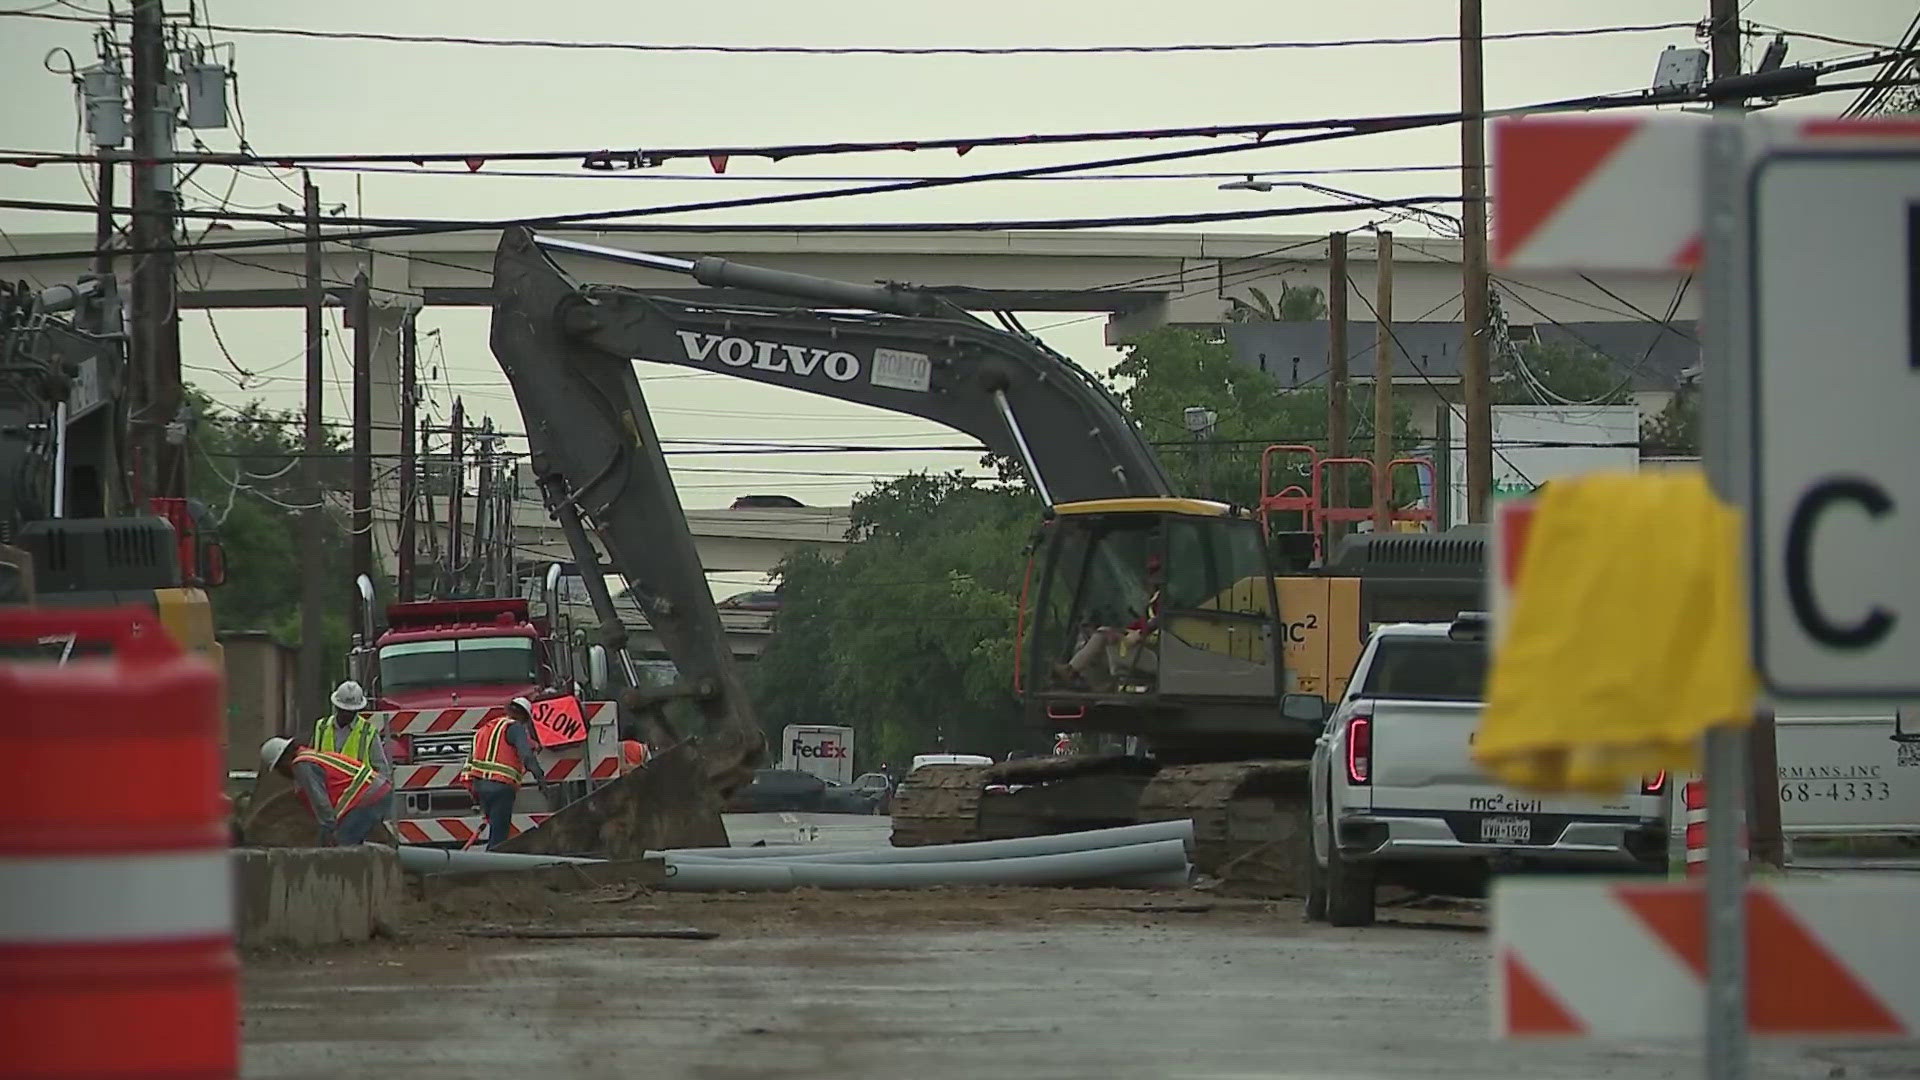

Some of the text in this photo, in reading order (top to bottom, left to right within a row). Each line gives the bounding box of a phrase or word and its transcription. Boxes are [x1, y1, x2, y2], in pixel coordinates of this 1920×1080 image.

[676, 330, 860, 381] VOLVO
[533, 703, 582, 739] SLOW
[417, 744, 472, 755] MAC
[792, 739, 847, 758] FedEx
[1780, 782, 1890, 802] 68-4333
[1506, 800, 1542, 812] civil
